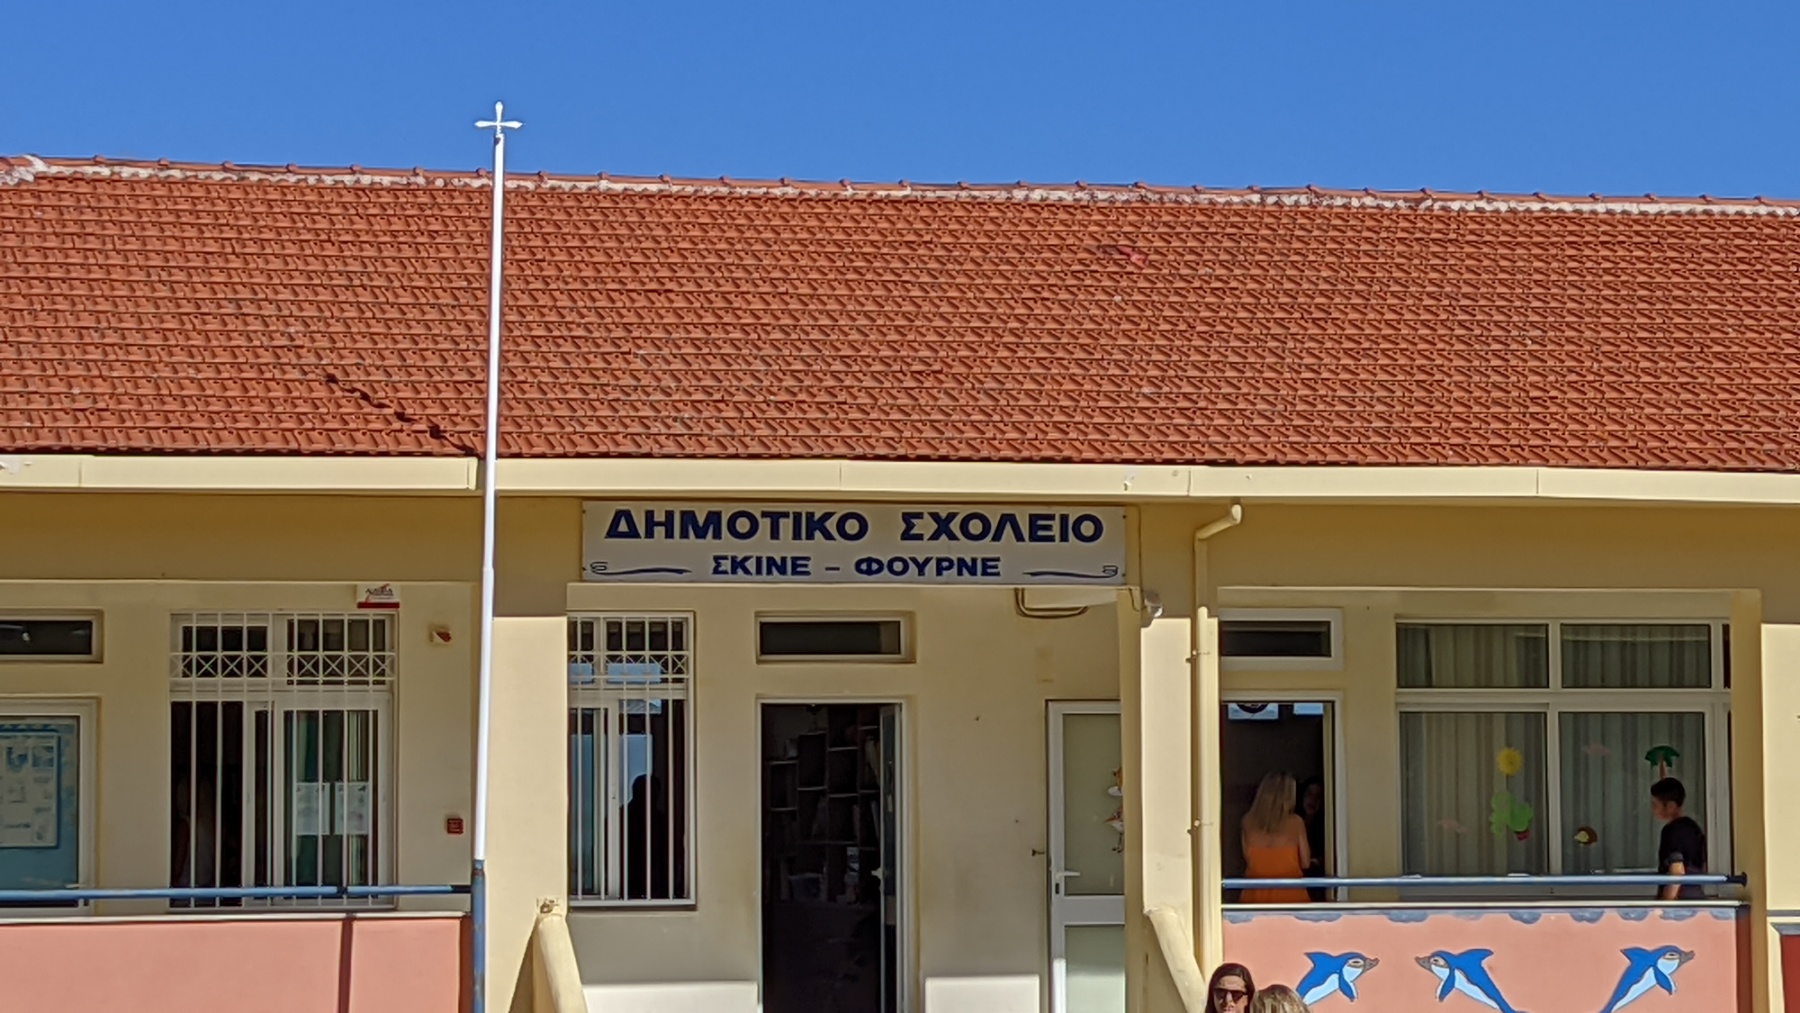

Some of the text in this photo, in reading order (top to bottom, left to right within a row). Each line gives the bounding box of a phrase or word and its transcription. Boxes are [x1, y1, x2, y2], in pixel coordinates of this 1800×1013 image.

[605, 509, 1103, 543] ΔΗΜΟΤΙΚΟ ΣΧΟΛΕΙΟ
[712, 555, 811, 576] ΣΚΙΝΕ
[855, 556, 1001, 577] ΦΟΥΡΝΕ
